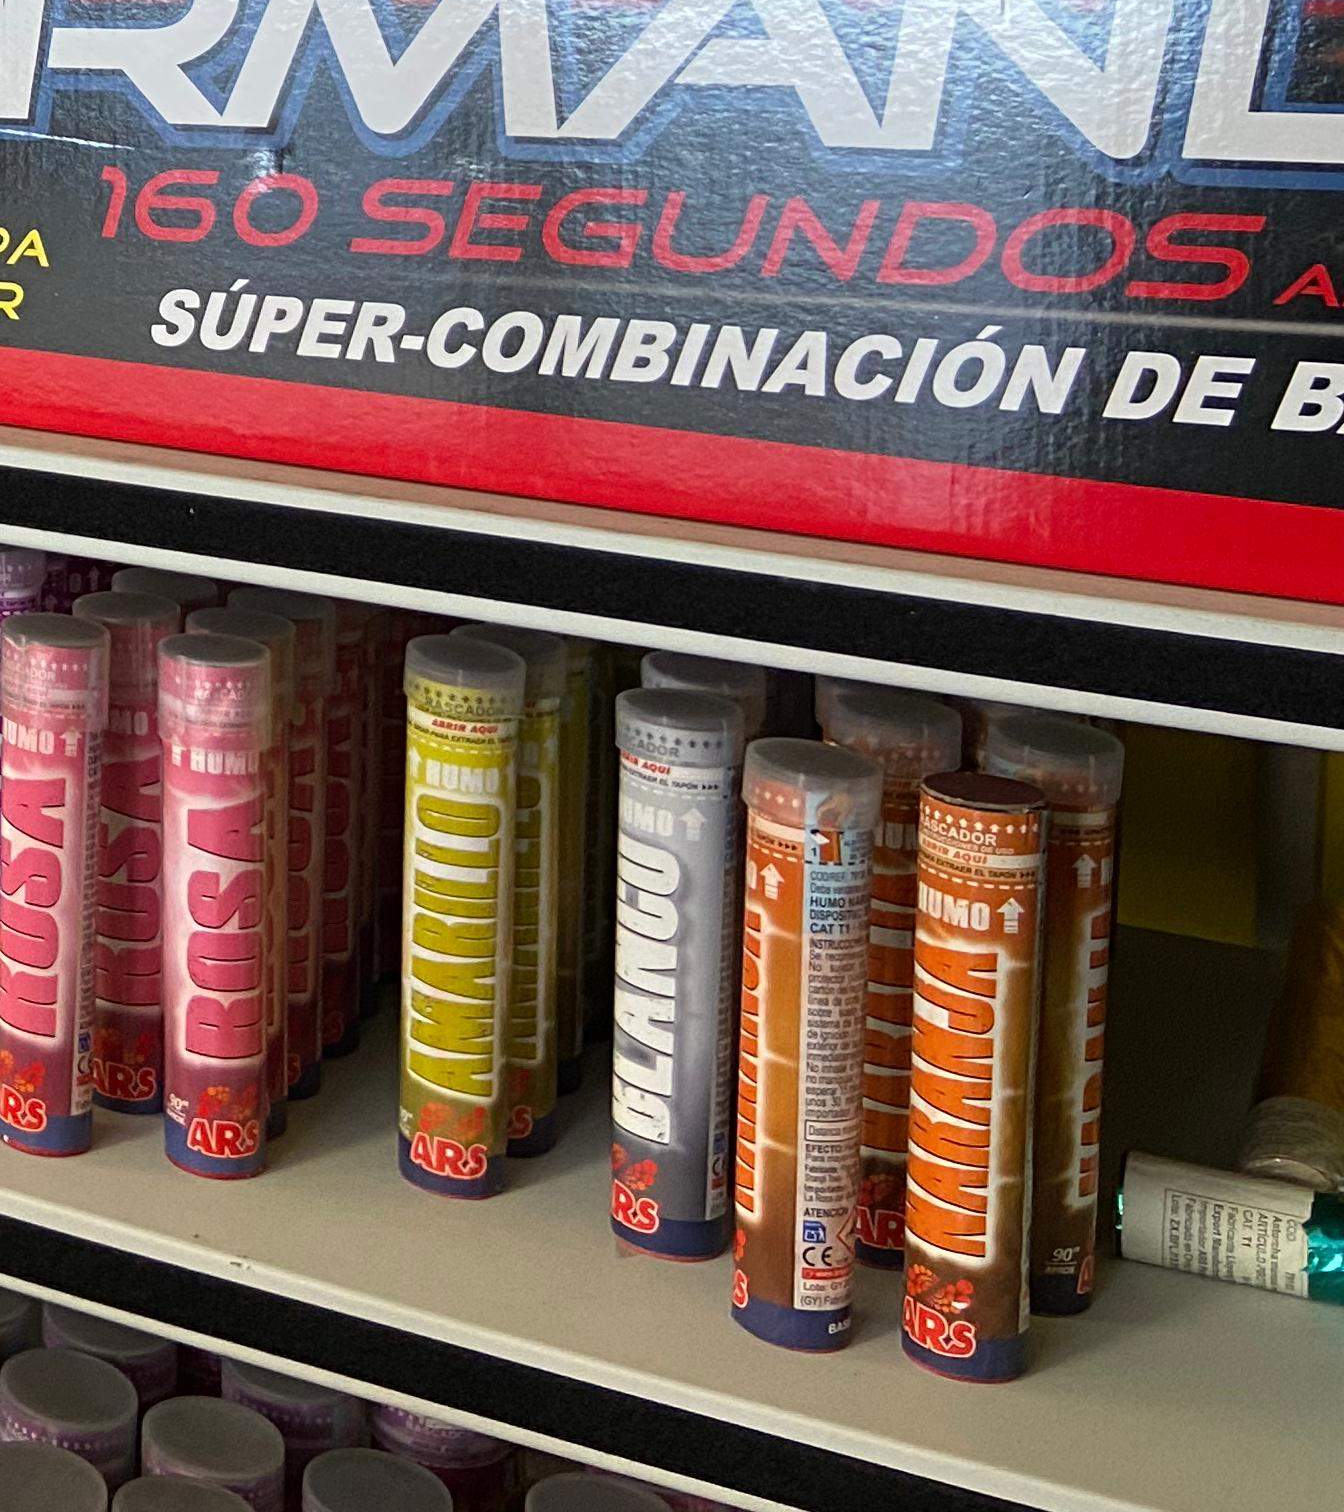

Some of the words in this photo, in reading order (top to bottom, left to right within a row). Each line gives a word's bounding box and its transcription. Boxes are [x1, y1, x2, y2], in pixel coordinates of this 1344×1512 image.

[99, 166, 320, 249] 160
[349, 176, 1268, 302] SEGUNDOS
[150, 279, 1086, 415] SÚPER-COMBINACIÓN
[1102, 350, 1259, 428] DE
[184, 792, 263, 1058] ROSA
[409, 798, 503, 1098] AMARILLO
[613, 839, 680, 1146] BLANCO
[410, 1132, 487, 1180] ARS
[906, 944, 1000, 1262] NARANJA
